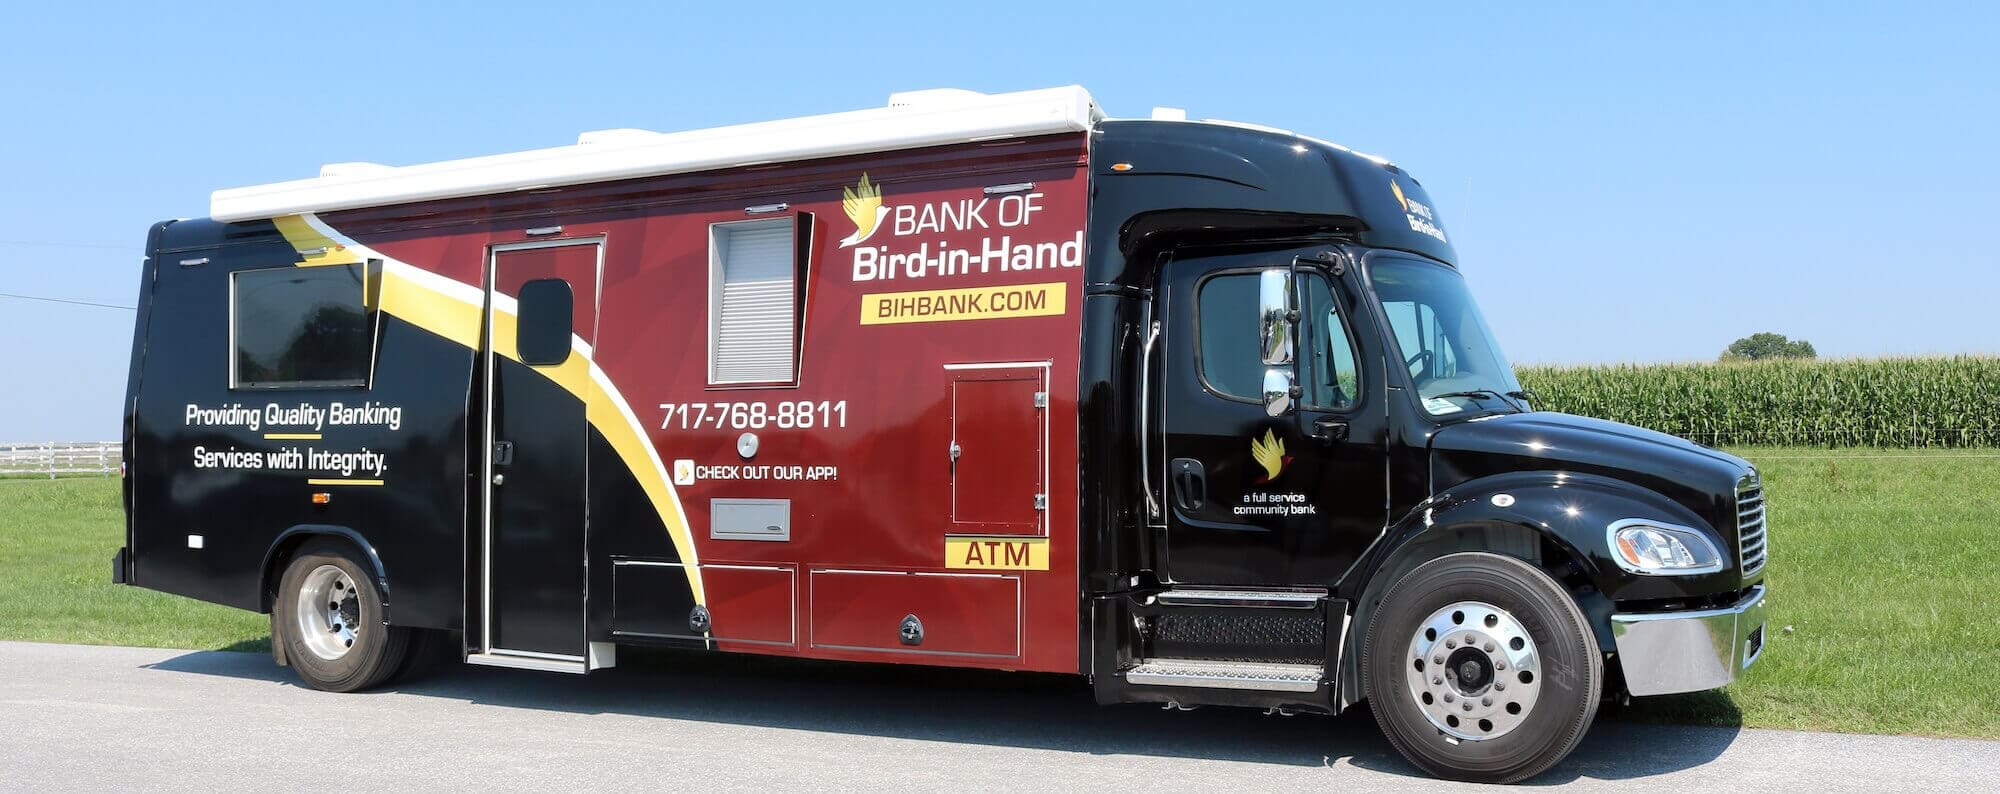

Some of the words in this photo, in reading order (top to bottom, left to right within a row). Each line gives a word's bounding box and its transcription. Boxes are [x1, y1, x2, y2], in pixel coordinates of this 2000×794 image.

[894, 198, 989, 236] BANK
[998, 192, 1044, 227] OF
[852, 230, 1084, 282] Bird-in-Hand
[878, 289, 1046, 318] BIHBANK.COM
[185, 403, 261, 431] Providing
[264, 402, 326, 431] Quality
[329, 401, 402, 431] Banking
[659, 400, 847, 430] 717-768-8811
[193, 446, 263, 469] Services
[267, 446, 304, 470] with
[307, 447, 388, 477] Integrity.
[695, 465, 740, 480] CHECK
[742, 465, 771, 480] OUT
[773, 466, 803, 481] OUR
[805, 466, 838, 481] APP!
[1233, 503, 1289, 517] community
[1290, 503, 1316, 515] bank
[1243, 494, 1250, 503] a
[1252, 492, 1267, 503] full
[1269, 491, 1306, 503] service
[965, 541, 1030, 567] ATM
